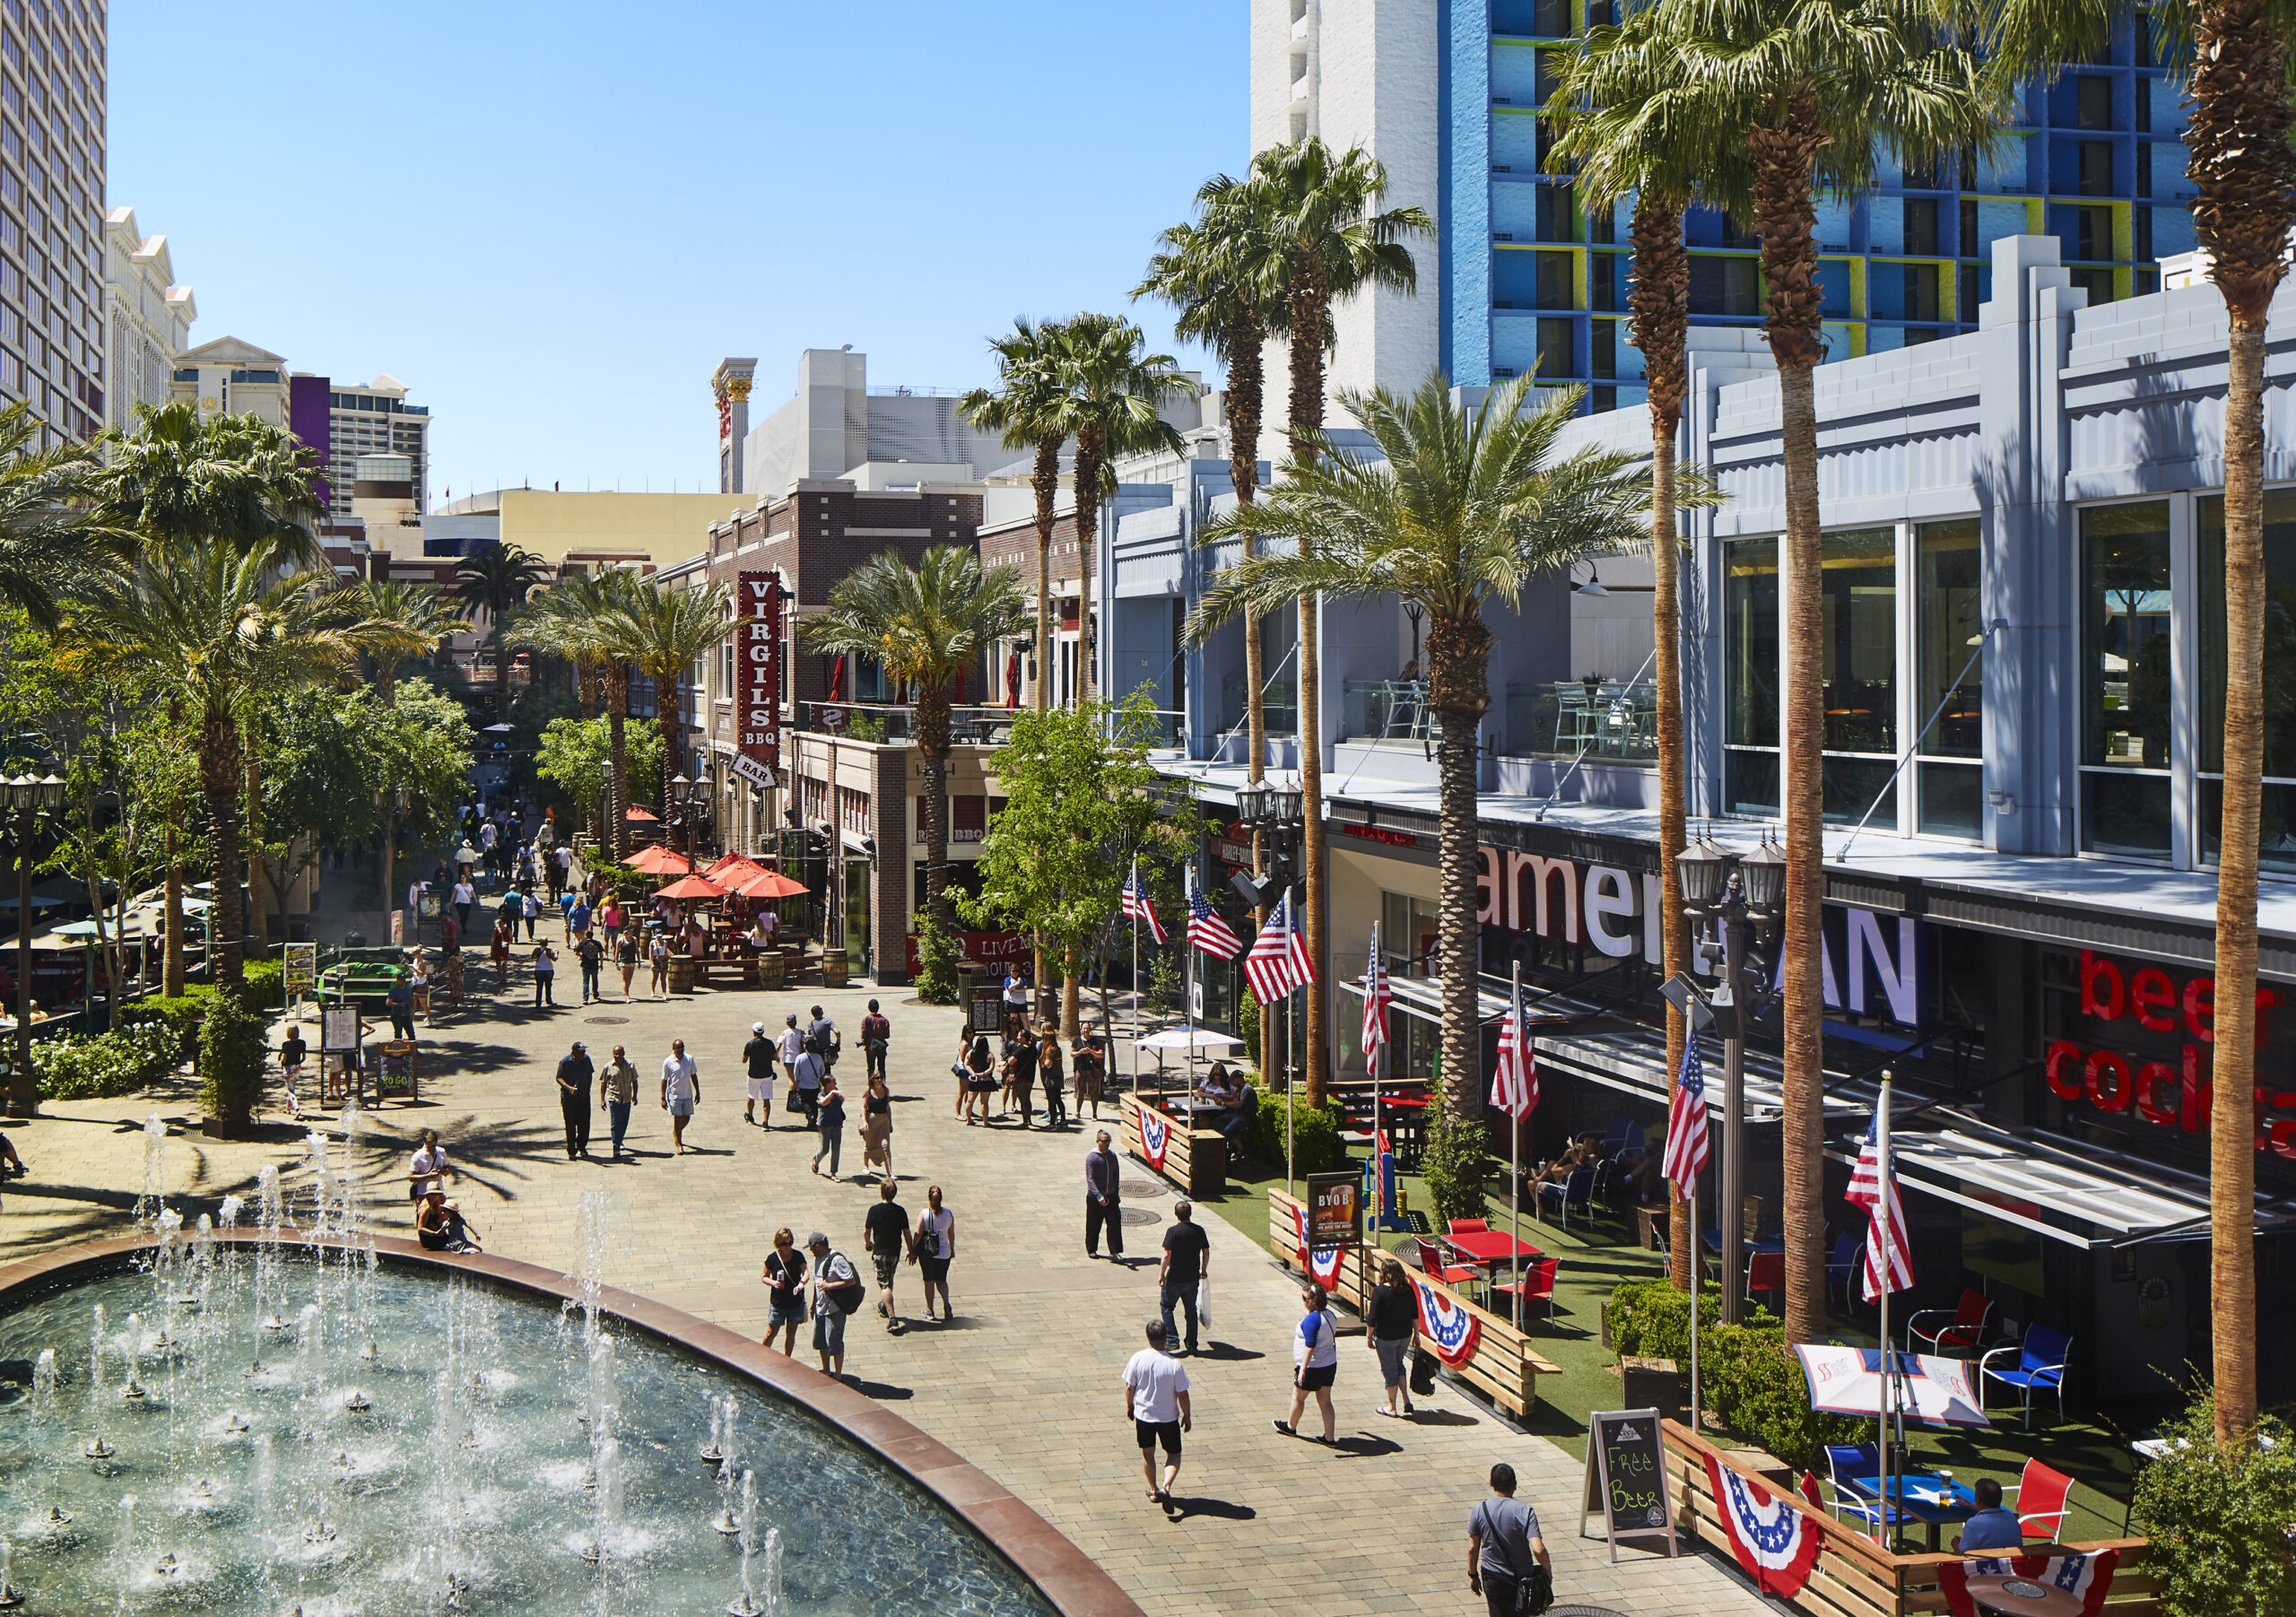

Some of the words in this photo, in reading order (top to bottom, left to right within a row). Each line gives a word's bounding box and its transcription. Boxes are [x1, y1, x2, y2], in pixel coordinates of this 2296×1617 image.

[748, 581, 772, 727] VIRGILS
[745, 732, 775, 745] BBQ
[741, 761, 769, 782] BAR
[953, 829, 984, 840] BBQ
[981, 936, 1017, 955] LIVE
